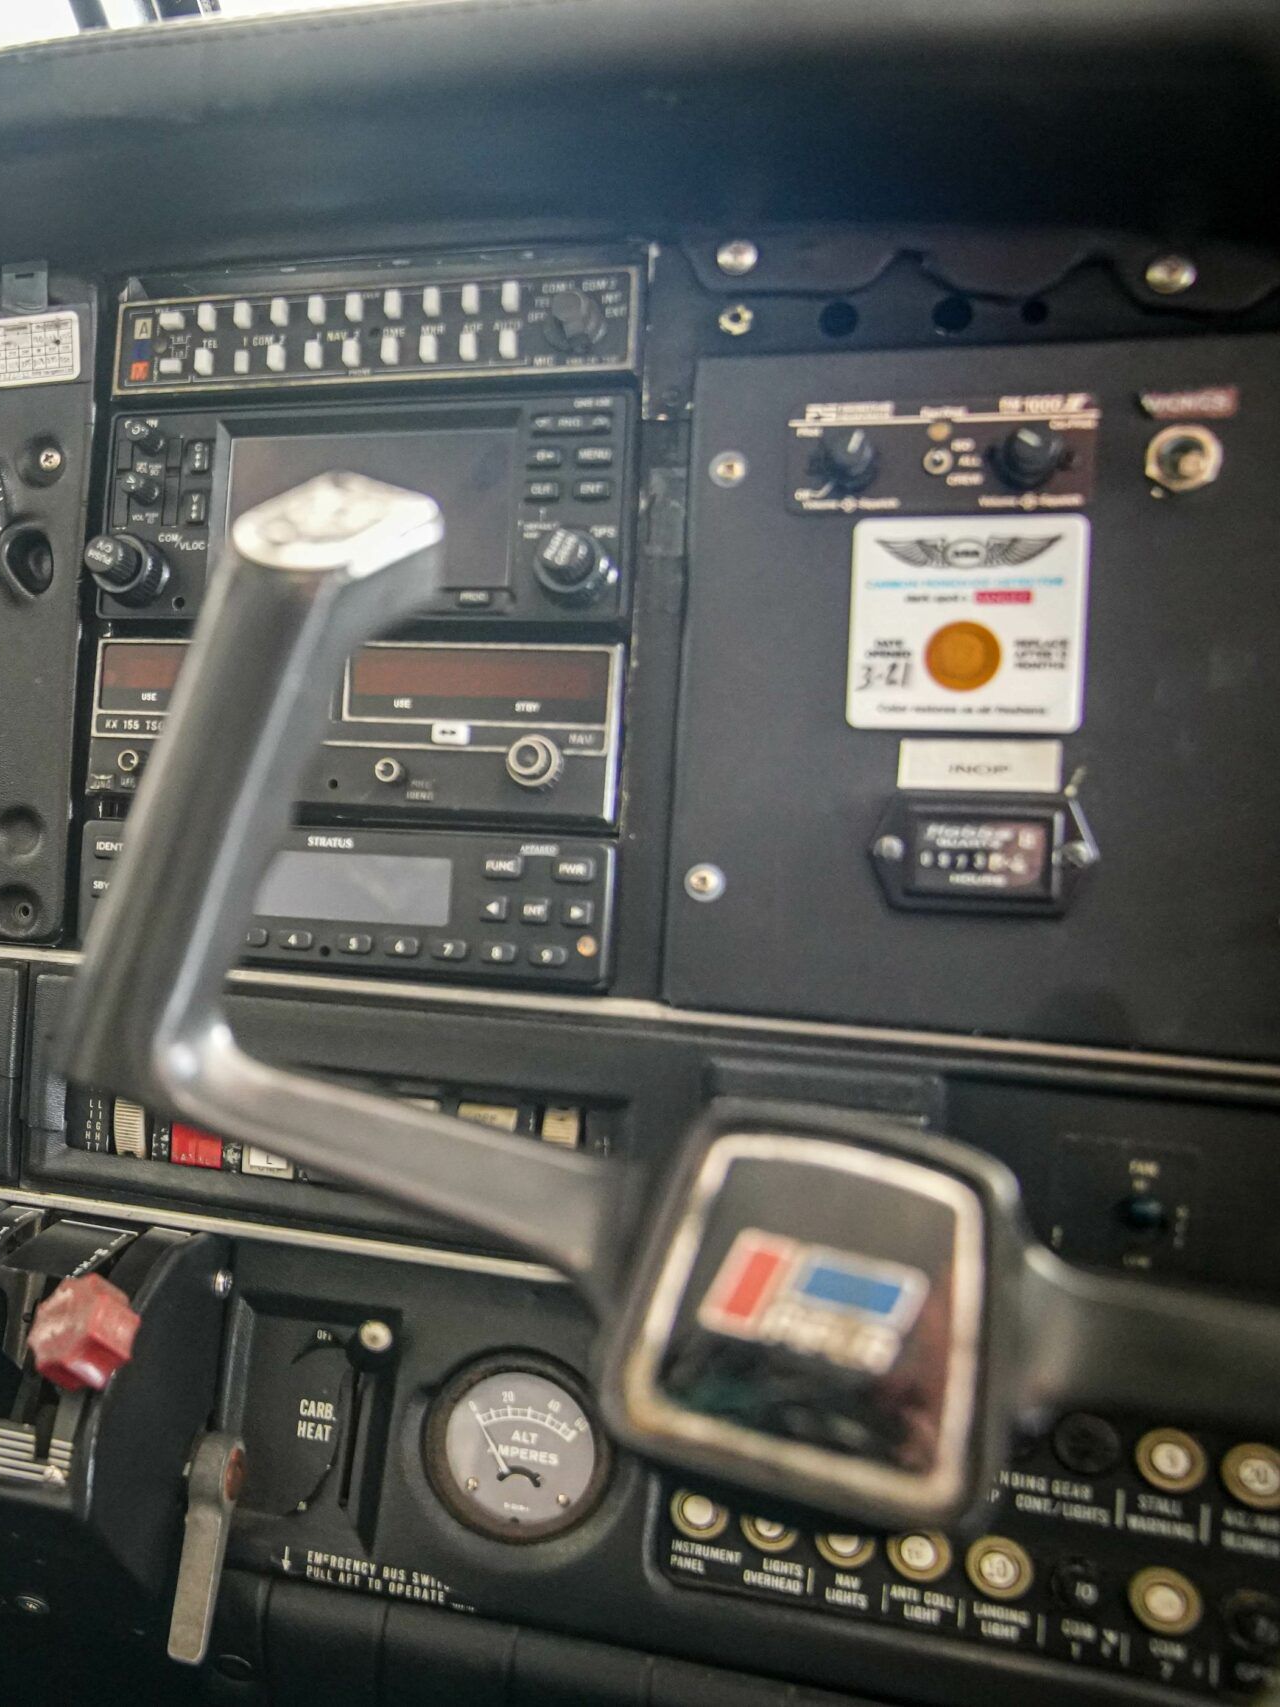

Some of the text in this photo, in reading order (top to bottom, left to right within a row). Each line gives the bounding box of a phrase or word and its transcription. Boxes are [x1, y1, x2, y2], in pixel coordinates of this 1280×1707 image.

[252, 336, 274, 347] COM
[326, 330, 347, 342] NAV
[202, 339, 218, 349] TEL
[577, 448, 613, 460] MENU
[579, 482, 603, 494] ENT
[179, 541, 206, 551] VLOC
[141, 692, 158, 701] USE
[514, 702, 541, 713] STBY
[105, 719, 140, 730] KX 155
[96, 841, 124, 852] IDENT
[307, 836, 354, 850] STRATUS
[485, 859, 515, 873] FUNC
[558, 863, 585, 876] PWR
[523, 903, 544, 917] ENT
[287, 933, 297, 946] 4
[394, 939, 405, 953] 6
[442, 942, 453, 956] 7
[541, 948, 553, 963] 9
[85, 1099, 94, 1151] LIGHT
[94, 1100, 102, 1152] LIGHT
[299, 1398, 337, 1421] CARB.
[297, 1421, 333, 1442] HEAT
[510, 1429, 539, 1446] ALT
[671, 1539, 743, 1565] INSTRUMENT
[307, 1550, 406, 1583] EMERGENCY BUS
[670, 1554, 706, 1575] PANEL
[762, 1557, 805, 1577] LIGHTS
[306, 1565, 446, 1604] PULL AFT TO OPERATE
[743, 1569, 804, 1596] OVERHEAD
[834, 1572, 862, 1590] NAV
[825, 1587, 870, 1611] LIGHTS
